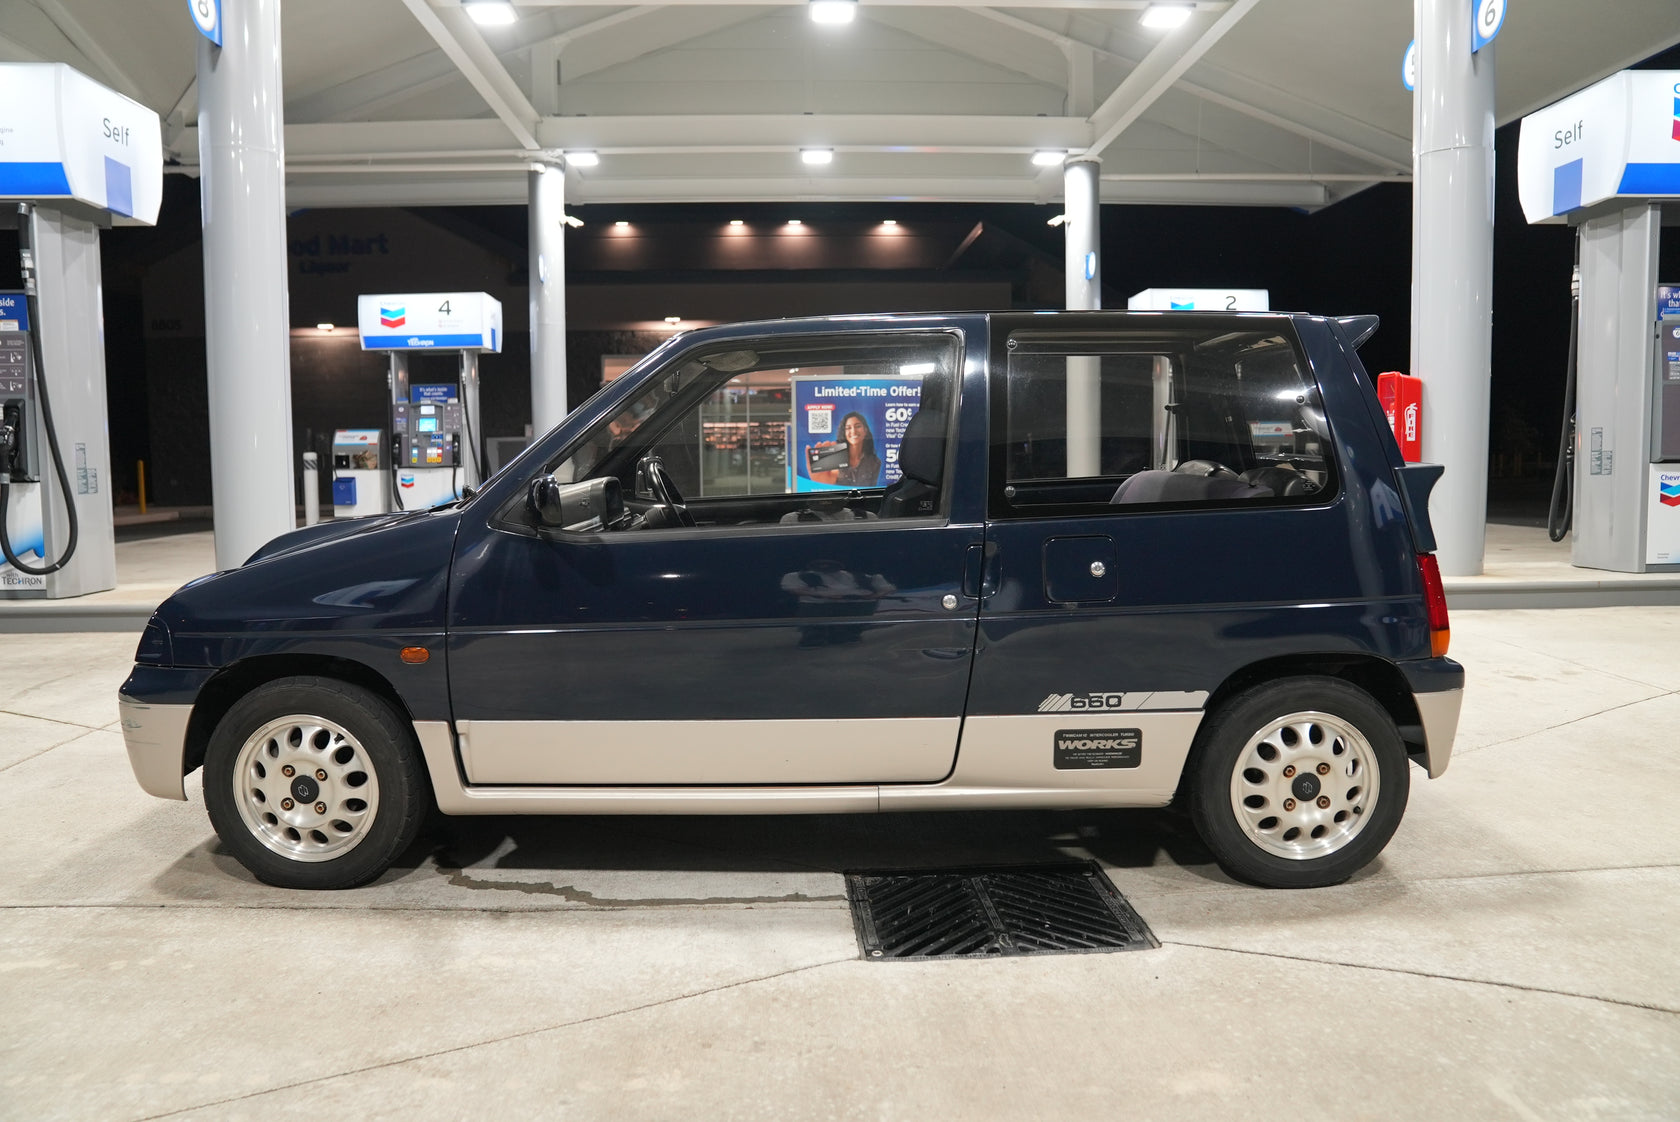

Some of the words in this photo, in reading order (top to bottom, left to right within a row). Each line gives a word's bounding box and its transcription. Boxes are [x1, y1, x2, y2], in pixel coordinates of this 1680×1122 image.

[1484, 0, 1496, 27] 6
[102, 117, 130, 147] Self
[1554, 119, 1584, 149] Self
[328, 233, 388, 256] Mart
[438, 299, 452, 316] 4
[1225, 295, 1237, 311] 2
[814, 386, 887, 397] Limited-Time
[889, 385, 921, 397] Offer!
[2, 576, 42, 586] TECHRON
[1070, 694, 1122, 709] 660
[1058, 738, 1138, 750] WORKS
